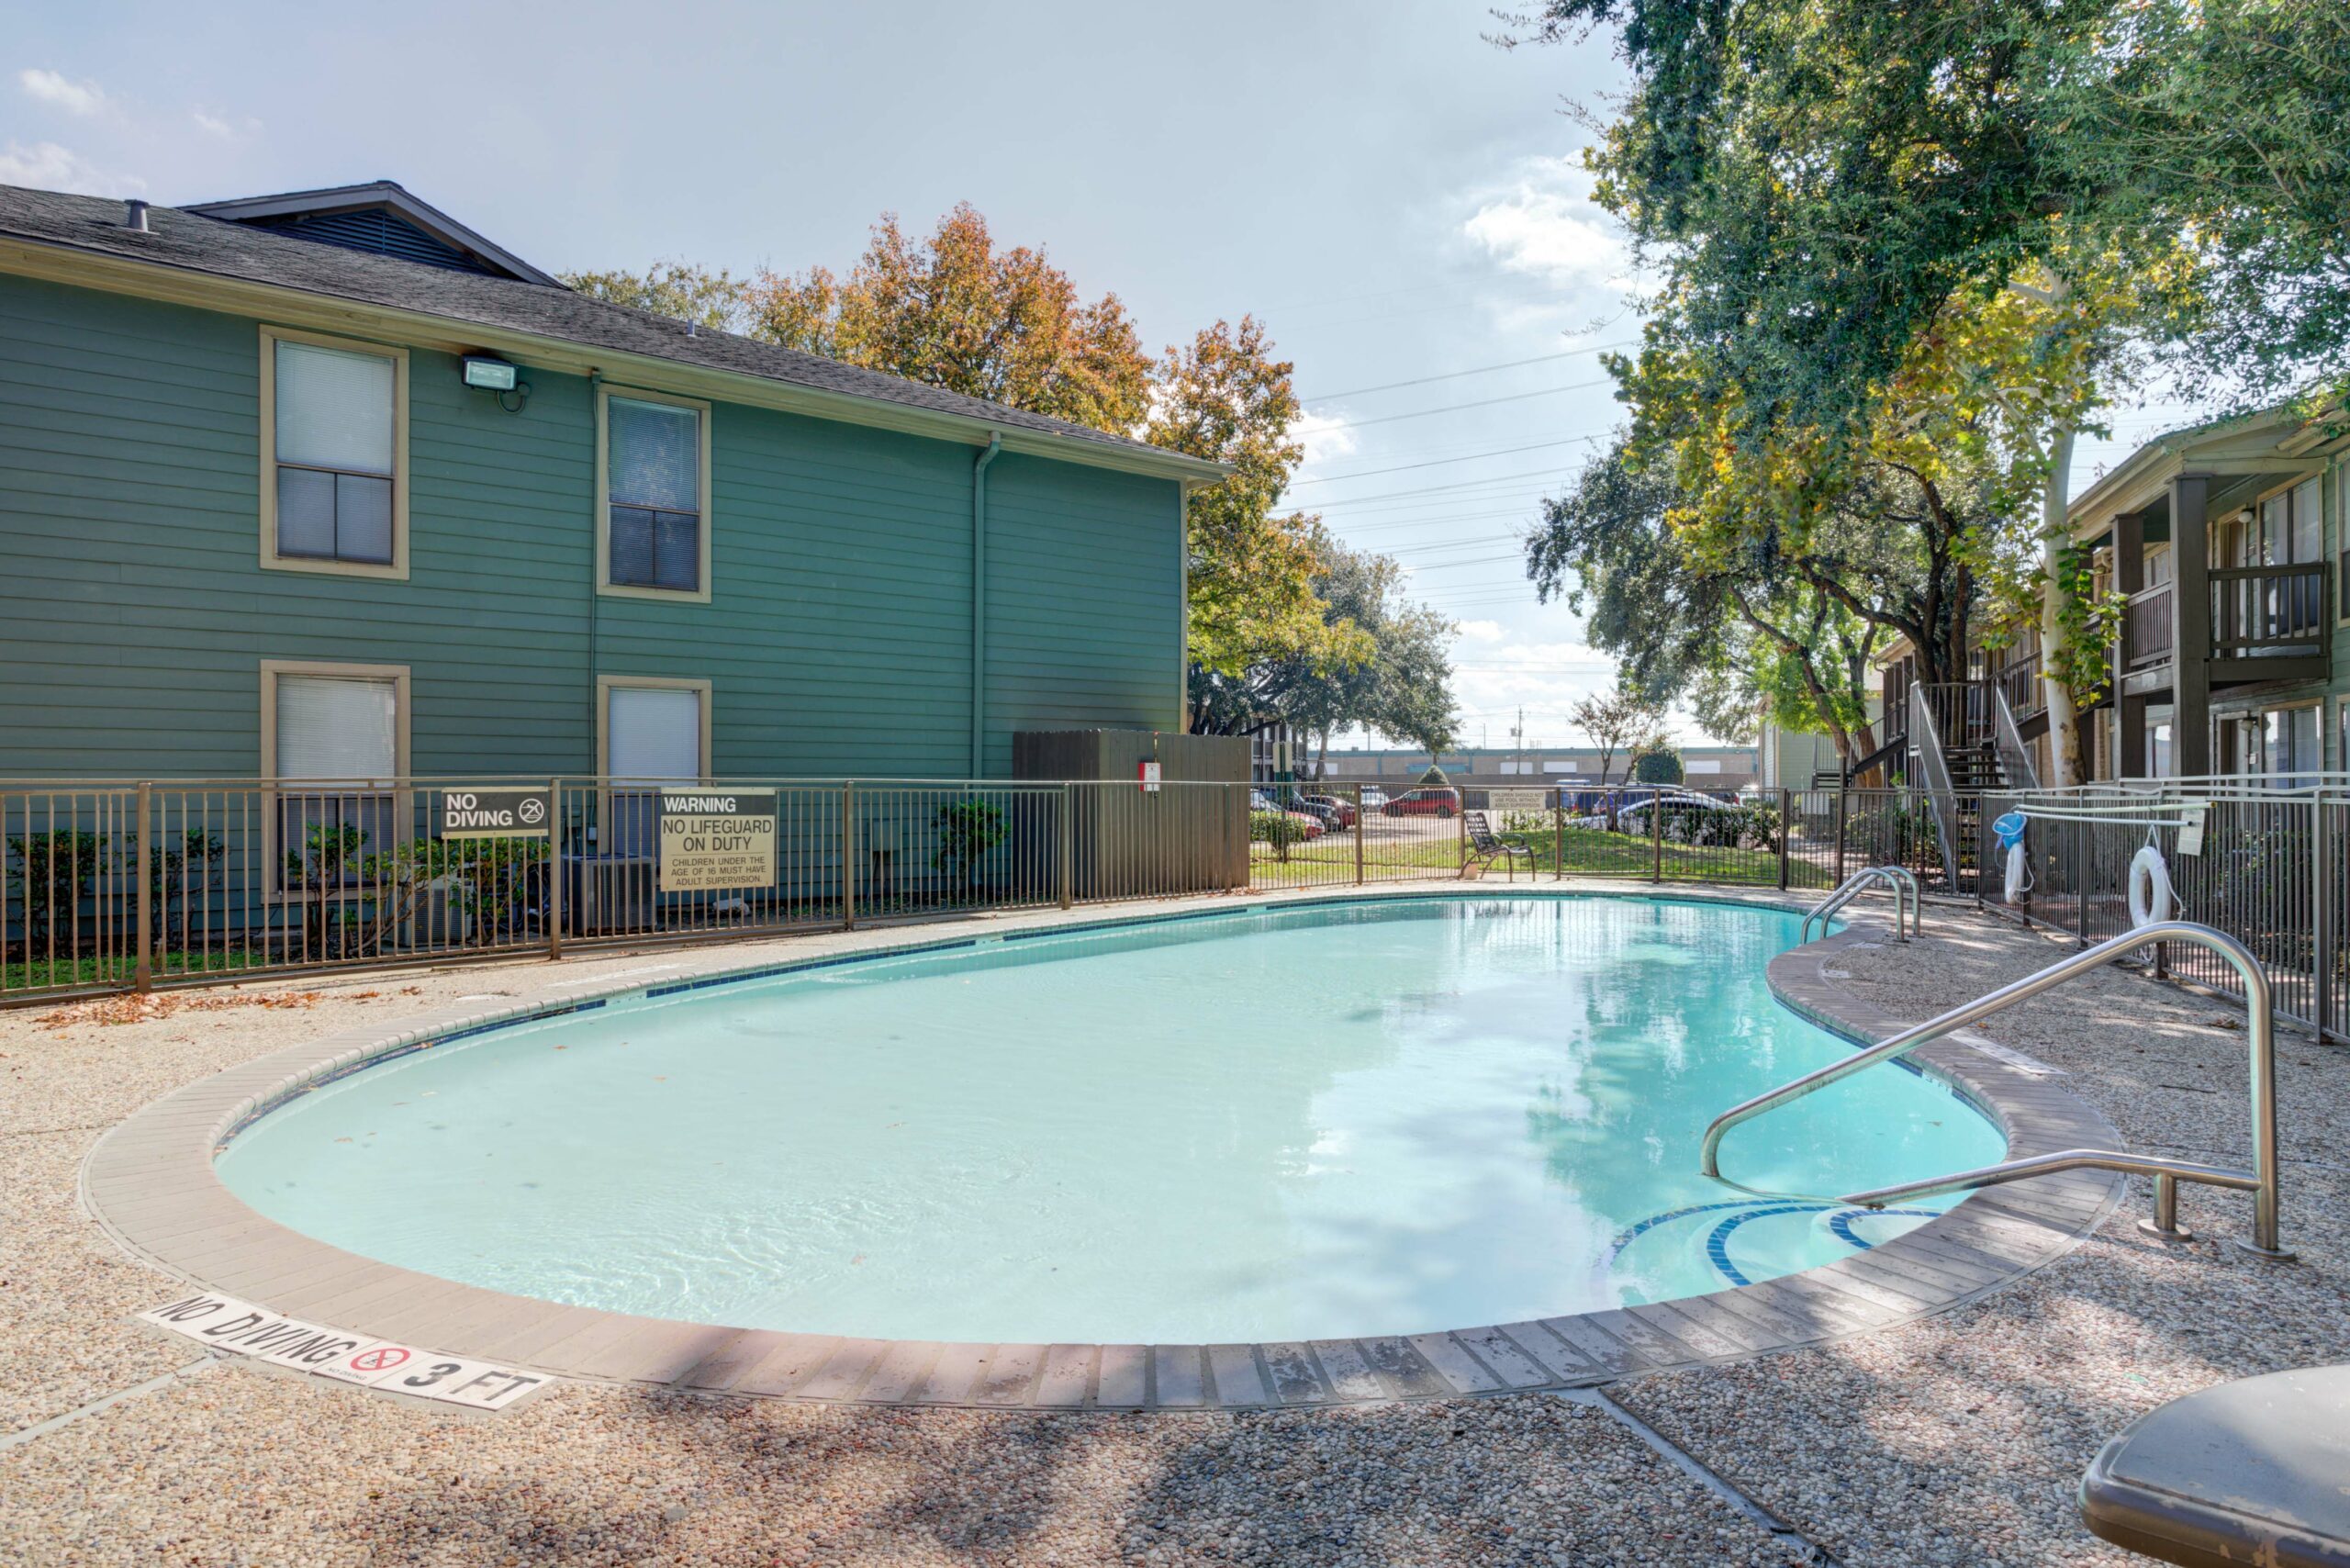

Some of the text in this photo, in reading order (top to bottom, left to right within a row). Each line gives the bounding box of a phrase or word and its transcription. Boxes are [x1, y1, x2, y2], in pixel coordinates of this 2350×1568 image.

[446, 794, 477, 810] NO
[664, 797, 736, 812] WARNING
[446, 810, 513, 826] DIVING
[663, 819, 772, 834] NO LIFEGUARD
[683, 836, 752, 852] ON DUTY
[672, 856, 766, 868] CHILDREN UNDER THE
[671, 865, 767, 876] AGE OF 16 MUST HAVE
[676, 875, 763, 886] ADULT SUPERVISION.
[151, 1296, 358, 1365] NO DIVING
[403, 1362, 542, 1402] 3 FT
